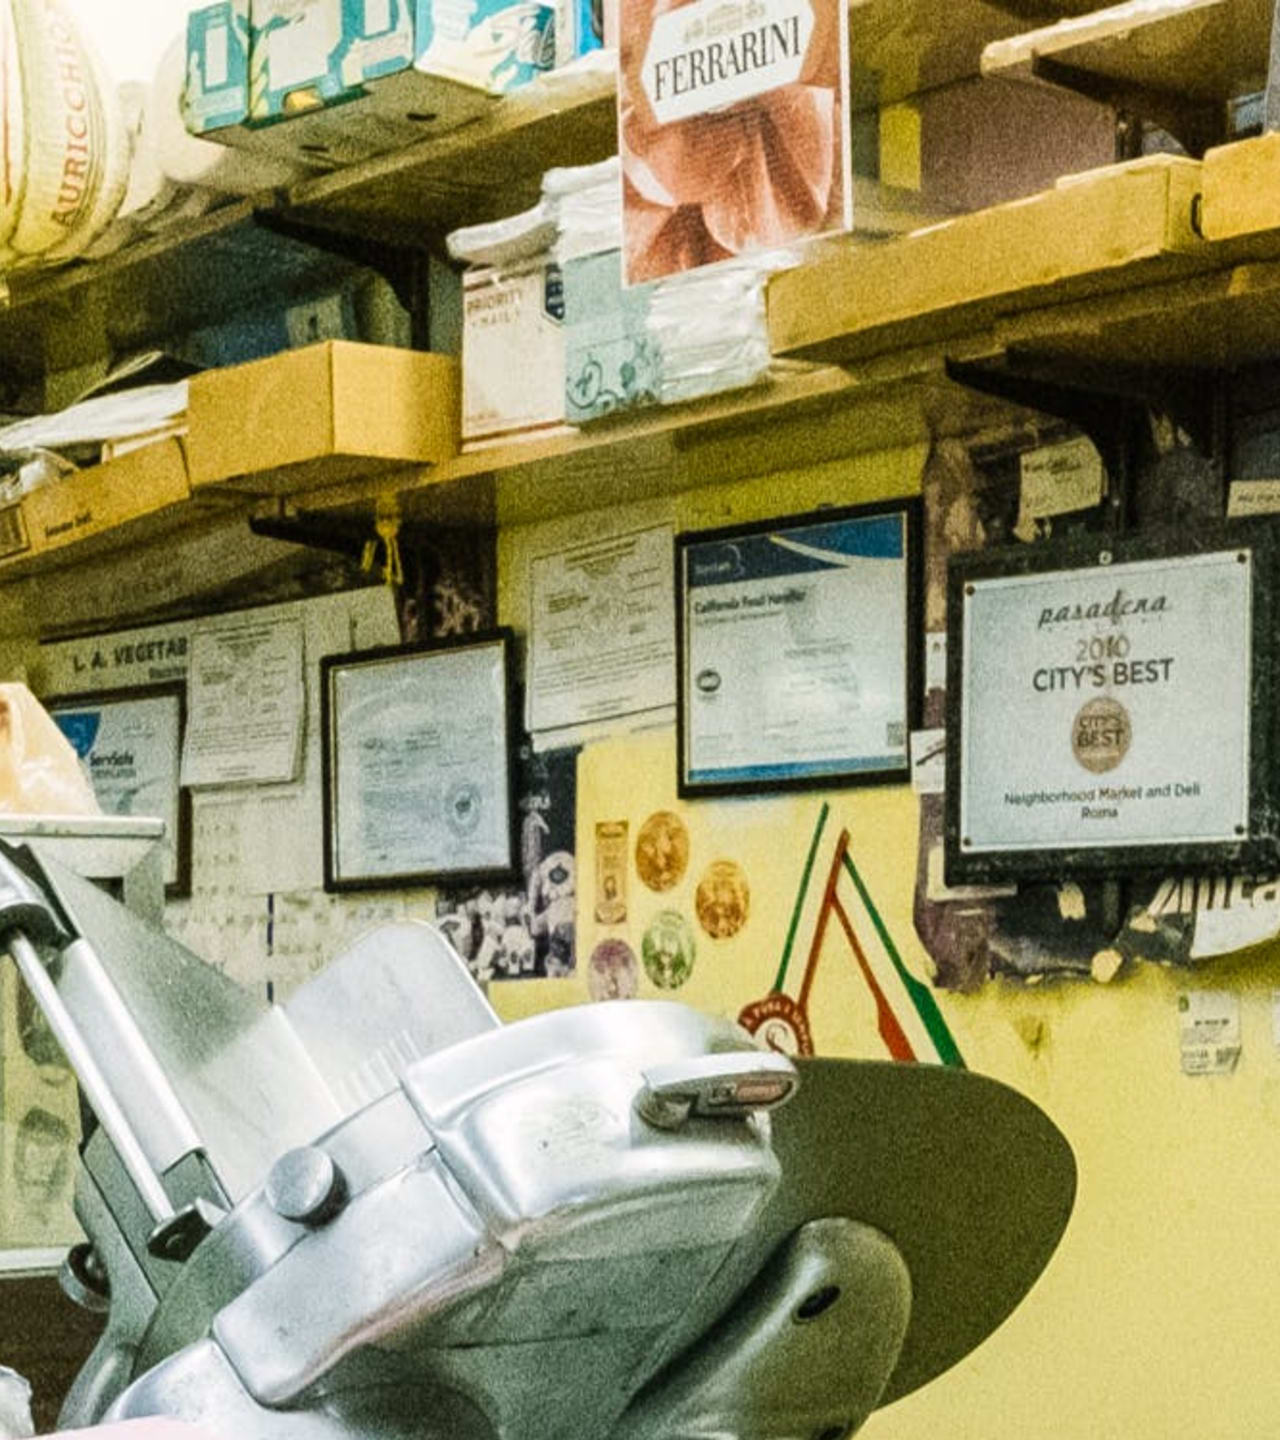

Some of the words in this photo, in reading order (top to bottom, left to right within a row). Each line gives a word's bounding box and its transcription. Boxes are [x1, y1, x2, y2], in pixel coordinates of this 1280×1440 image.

[654, 15, 801, 102] FERRARINI
[1033, 664, 1106, 692] CITY'S
[1113, 658, 1175, 686] BEST
[1077, 730, 1124, 748] BEST
[1005, 788, 1095, 807] Neighborhood
[1099, 786, 1143, 800] Market
[1146, 784, 1171, 799] and
[1175, 782, 1201, 797] Deli
[1081, 806, 1118, 819] Roma
